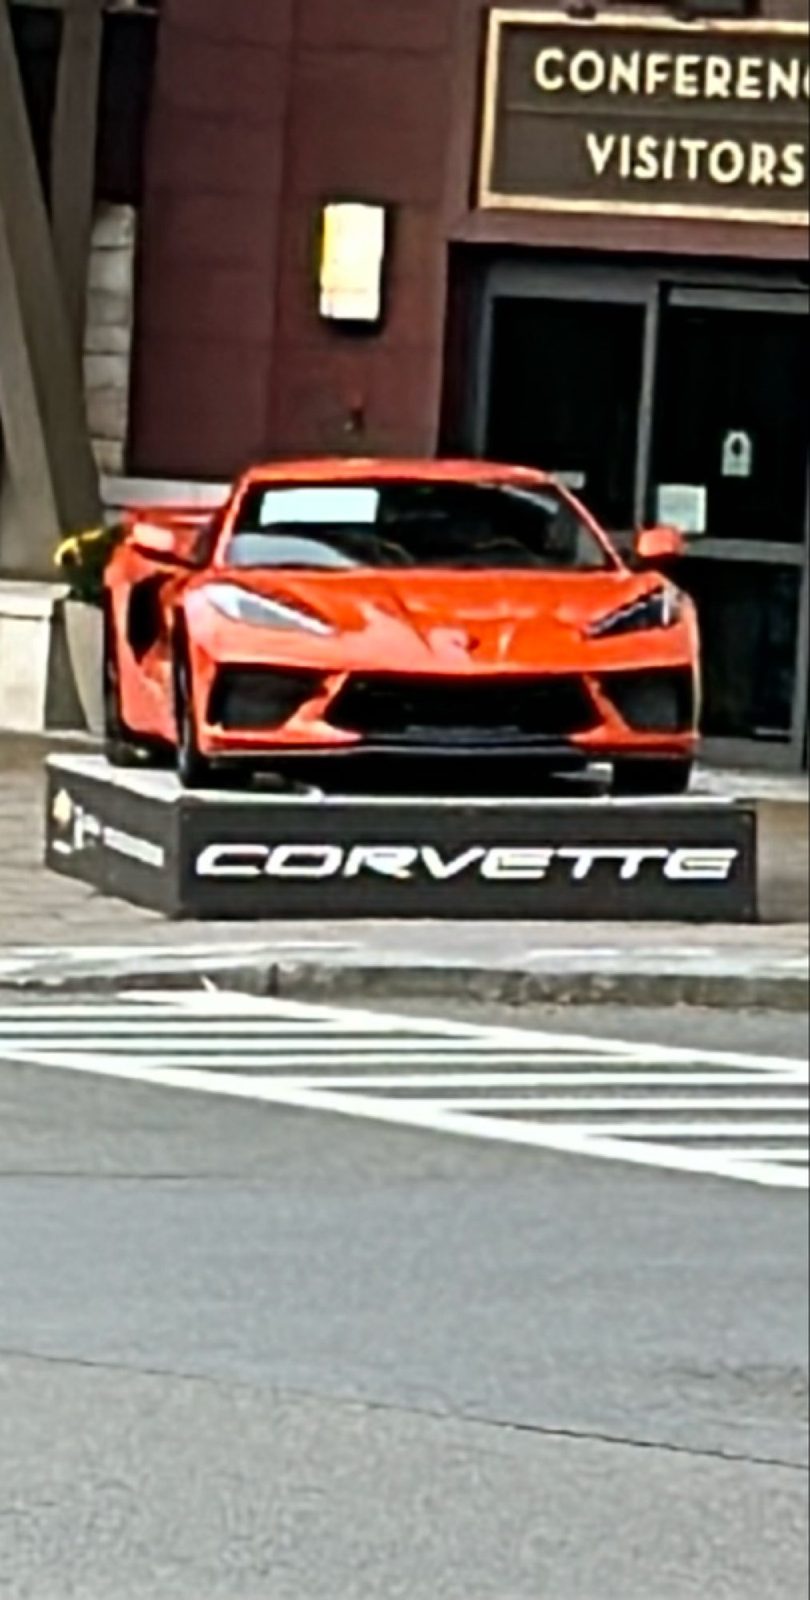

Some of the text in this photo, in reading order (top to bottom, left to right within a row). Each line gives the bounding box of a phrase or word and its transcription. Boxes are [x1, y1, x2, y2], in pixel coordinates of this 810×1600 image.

[534, 47, 809, 101] CONFEREN
[586, 132, 805, 186] VISITORS
[196, 843, 738, 879] CORVETTE
